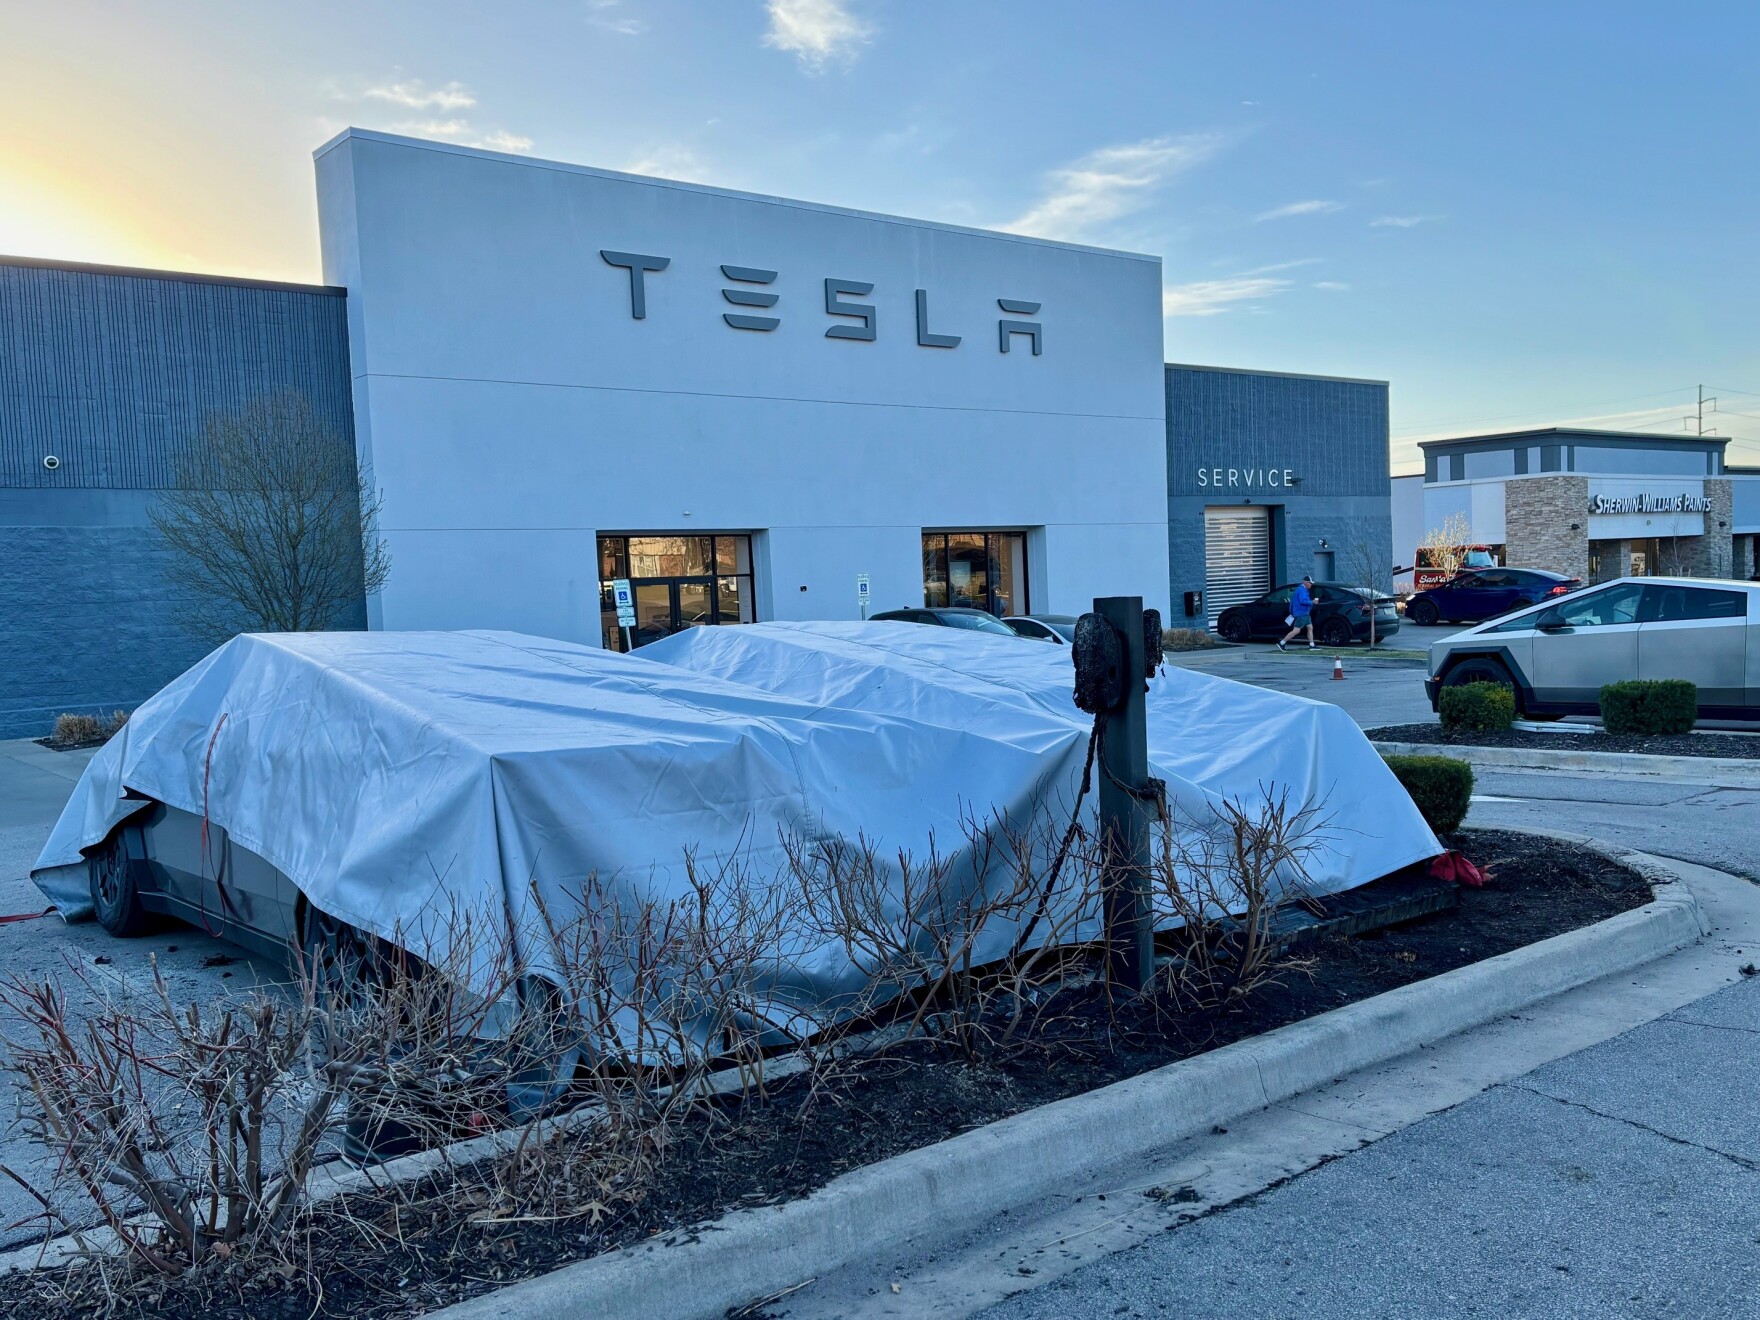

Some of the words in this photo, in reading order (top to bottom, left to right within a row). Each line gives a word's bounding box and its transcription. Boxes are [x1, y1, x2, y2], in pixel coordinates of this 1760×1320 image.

[599, 249, 1042, 356] TESLA
[1197, 467, 1294, 487] SERVICE
[1595, 493, 1682, 514] SHERWIN-WILLIAMS
[1683, 493, 1712, 512] PAINTS
